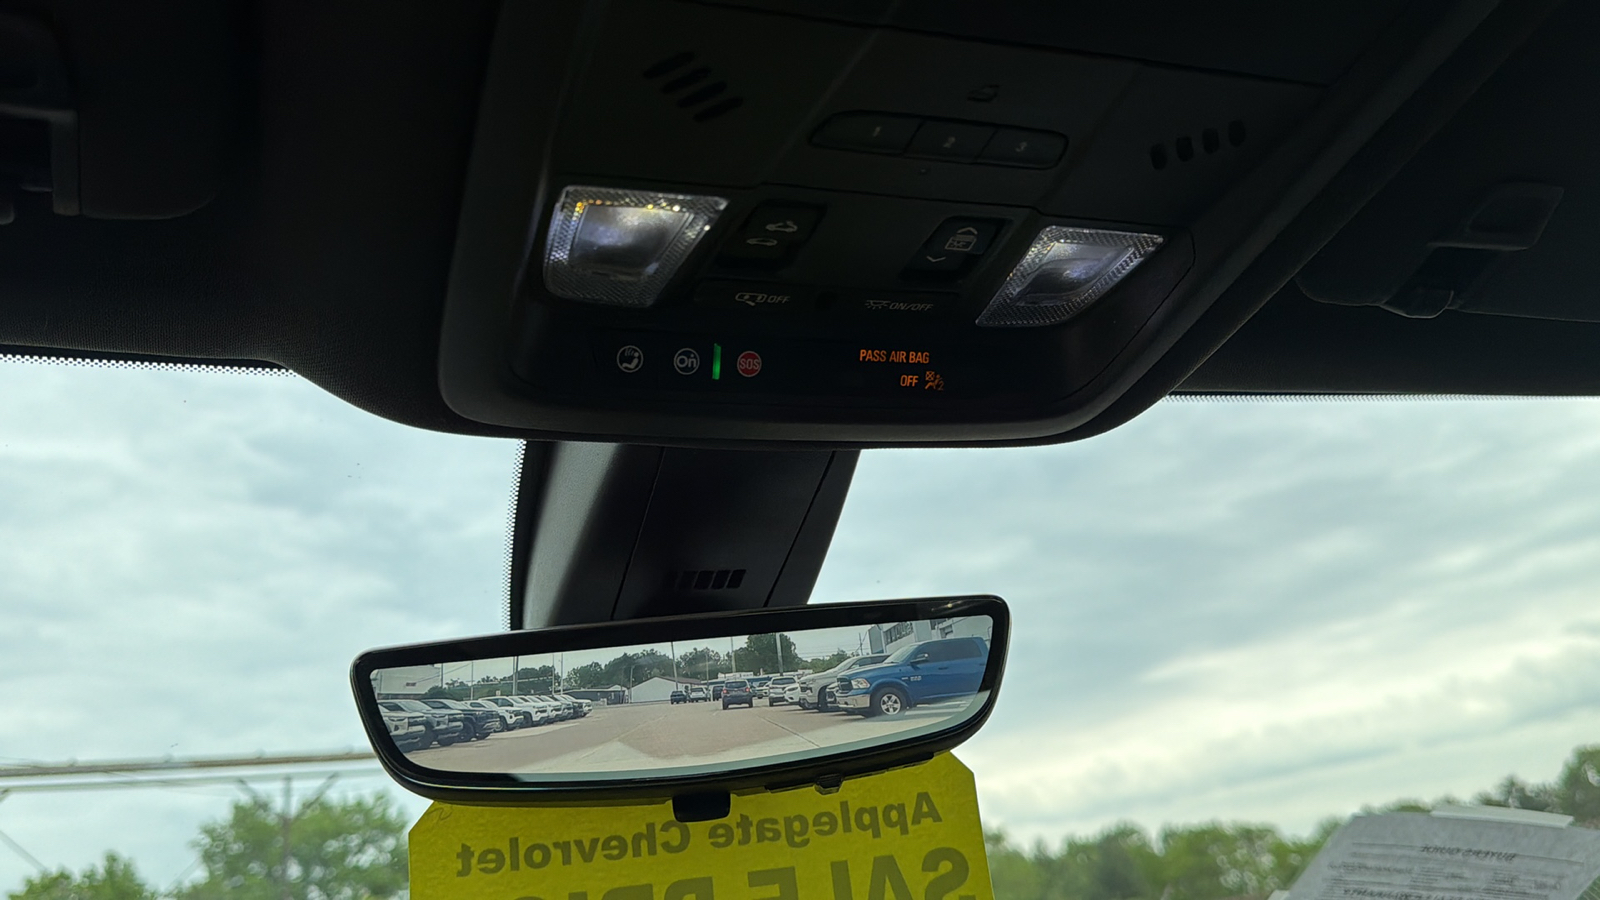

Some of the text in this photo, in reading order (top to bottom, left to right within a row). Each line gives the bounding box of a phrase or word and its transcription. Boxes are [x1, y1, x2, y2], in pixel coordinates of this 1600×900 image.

[1015, 141, 1028, 153] 3
[765, 294, 791, 305] OFF
[889, 301, 934, 312] ON/OFF
[859, 349, 930, 365] PASS AIR BAG
[738, 358, 761, 370] SOS
[899, 374, 919, 388] OFF
